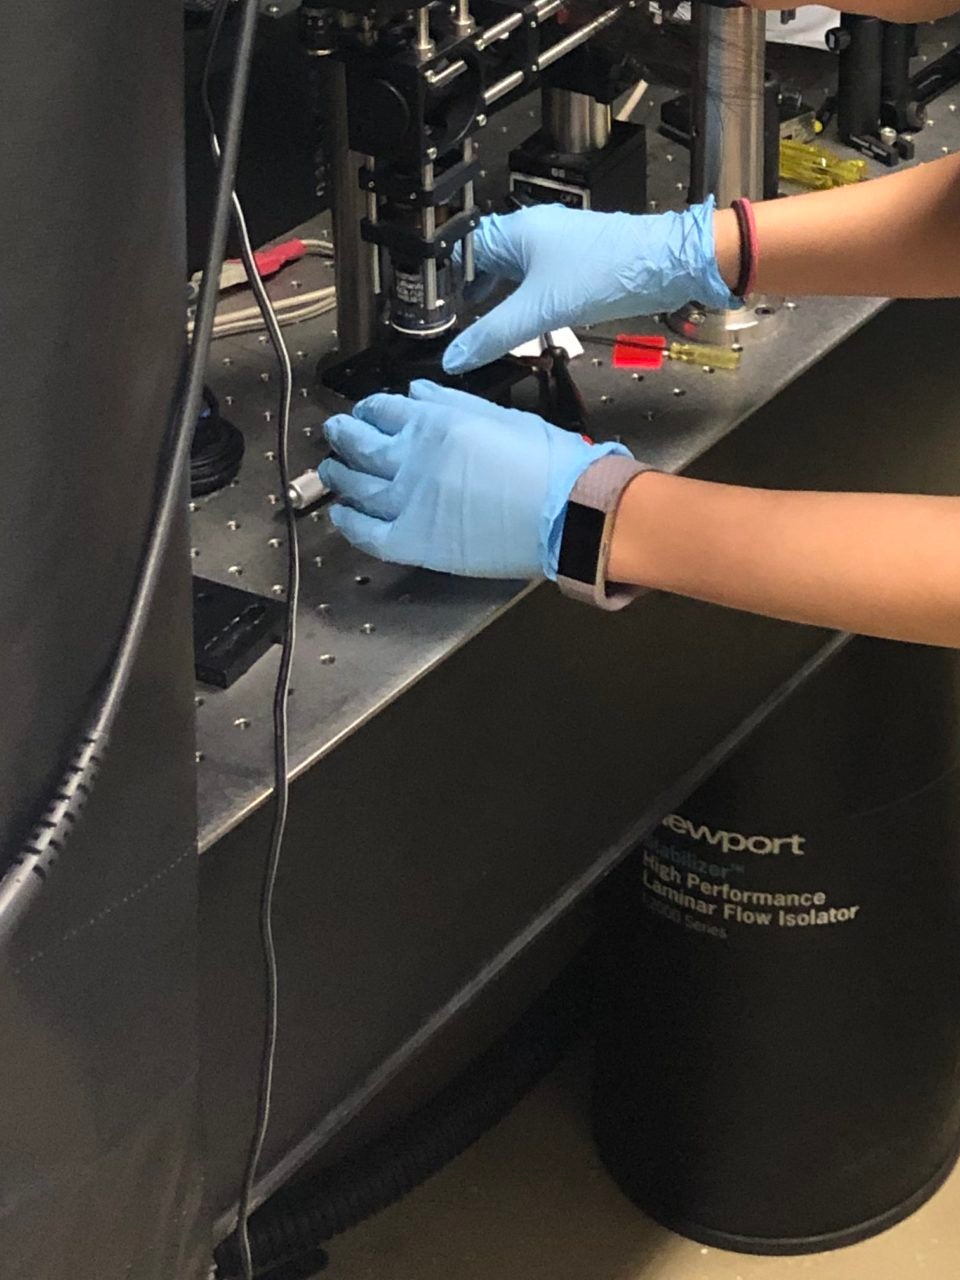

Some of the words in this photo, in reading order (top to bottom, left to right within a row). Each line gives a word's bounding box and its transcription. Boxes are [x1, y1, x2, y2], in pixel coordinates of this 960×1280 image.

[662, 813, 806, 856] ewport
[642, 850, 682, 883] High
[687, 873, 826, 907] Performance
[642, 869, 718, 916] Laminar
[723, 904, 772, 926] Flow
[778, 904, 860, 928] Isolator
